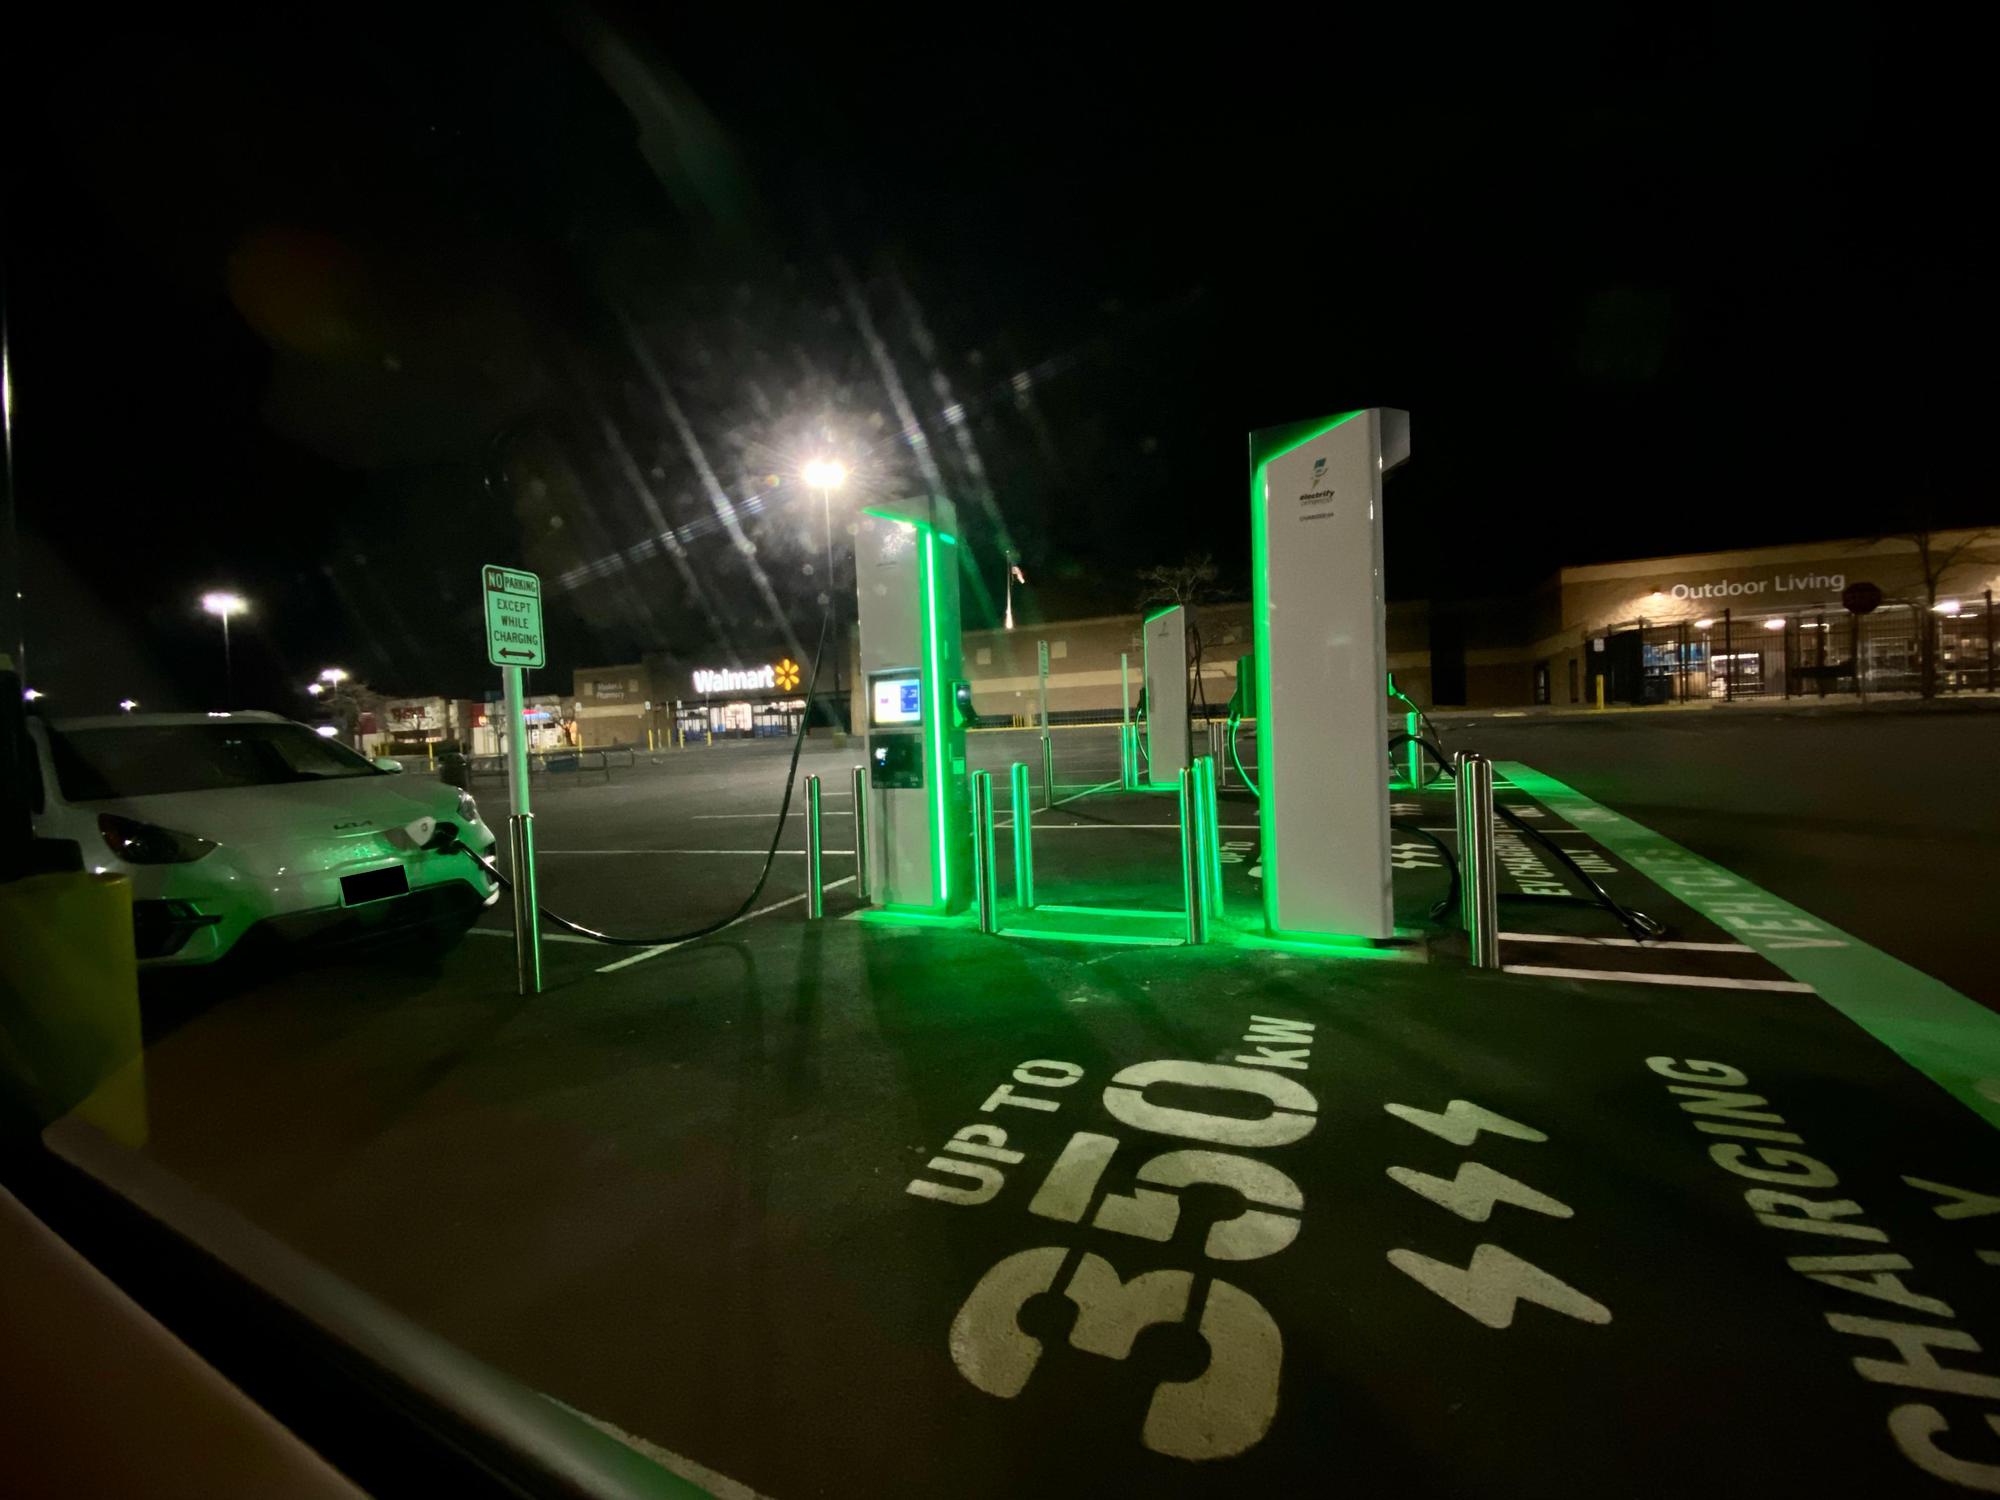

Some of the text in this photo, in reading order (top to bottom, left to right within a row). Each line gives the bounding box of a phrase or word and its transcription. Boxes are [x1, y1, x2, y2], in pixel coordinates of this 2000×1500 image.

[488, 571, 536, 592] NO PARKING
[1671, 571, 1846, 601] Outdoor Living
[497, 599, 531, 613] EXCEPT
[501, 615, 529, 629] WHILE
[493, 630, 539, 646] CHARGING
[692, 664, 775, 694] Walmart
[1515, 879, 1573, 896] EV
[905, 1058, 1085, 1206] UP TO
[949, 1059, 1318, 1462] 350
[1645, 1056, 2000, 1494] CHARGING
